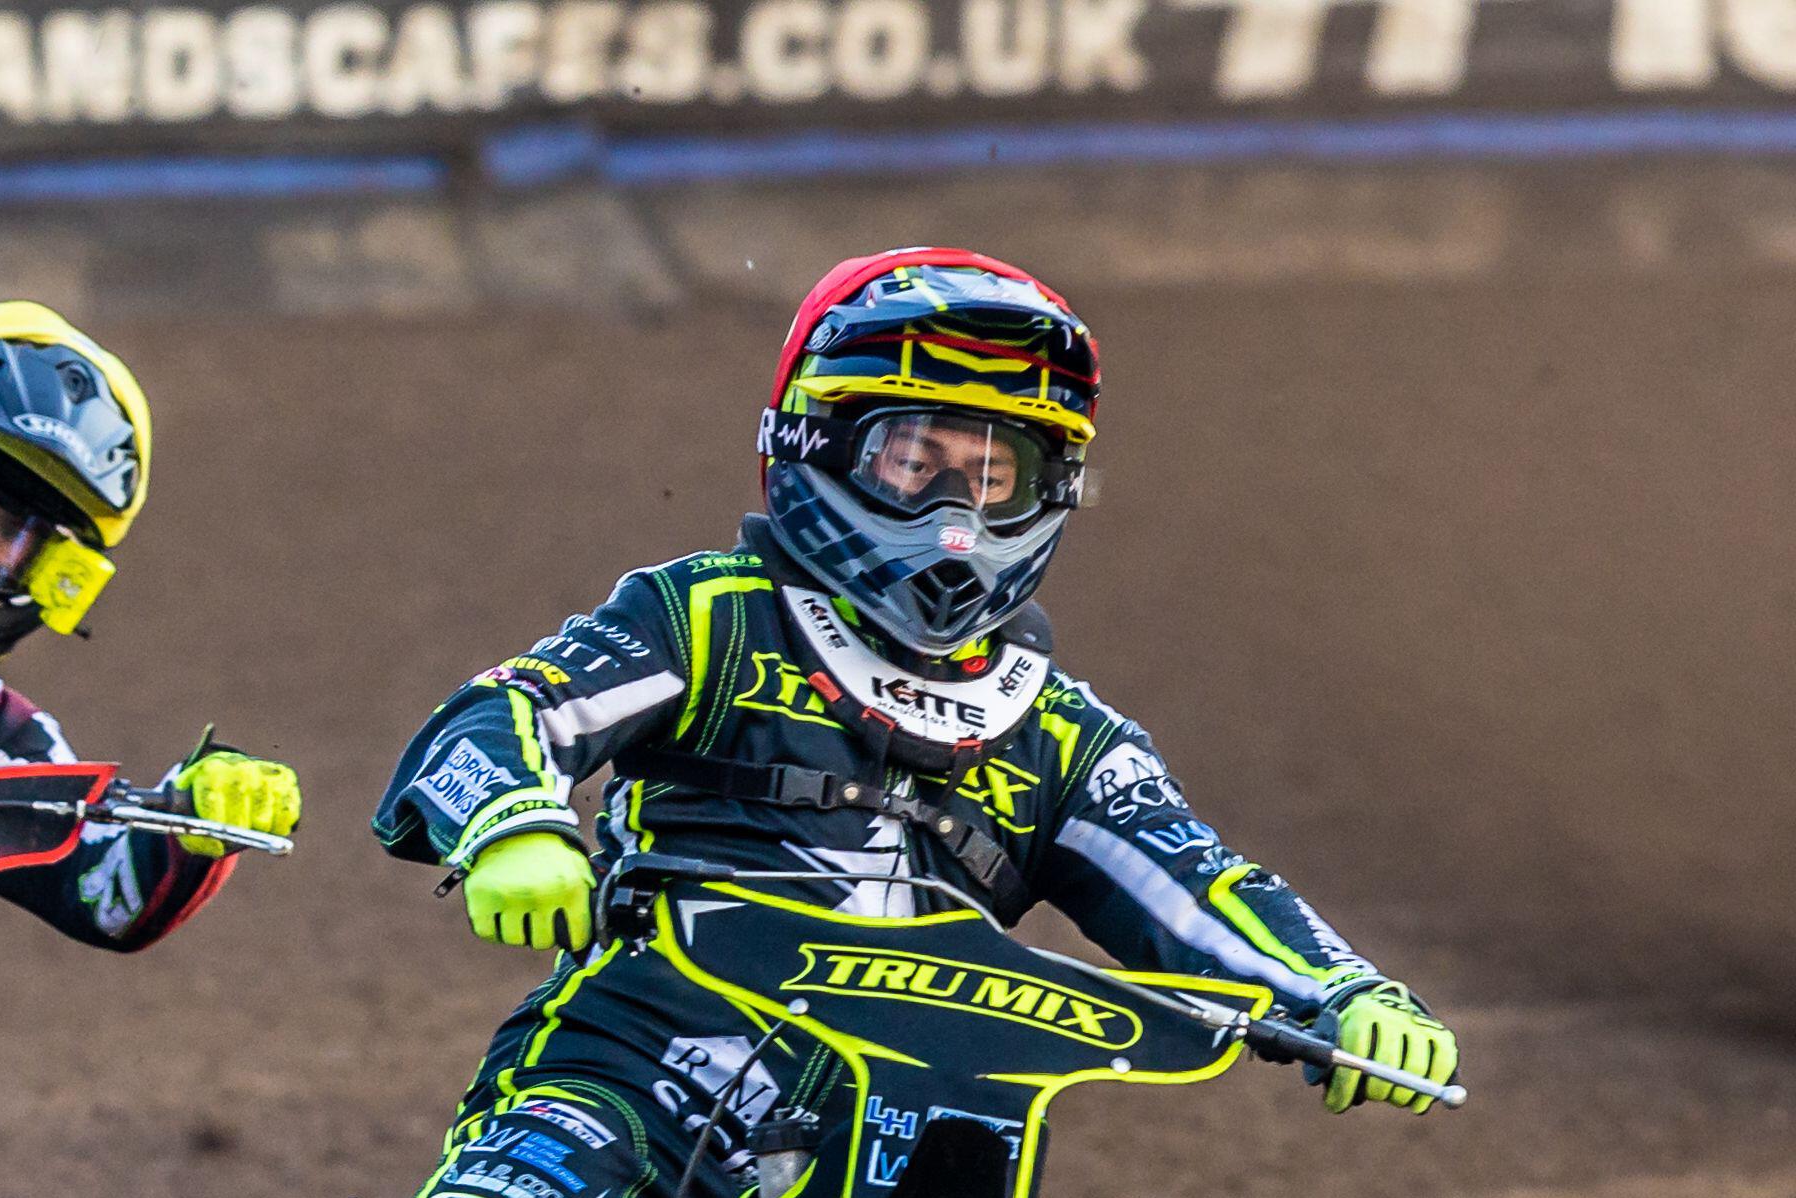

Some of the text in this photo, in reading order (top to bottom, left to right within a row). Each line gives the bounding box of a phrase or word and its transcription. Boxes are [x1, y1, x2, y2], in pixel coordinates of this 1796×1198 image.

[872, 676, 987, 730] KITE
[996, 655, 1033, 698] KITE
[826, 954, 1117, 1038] TRU MIX
